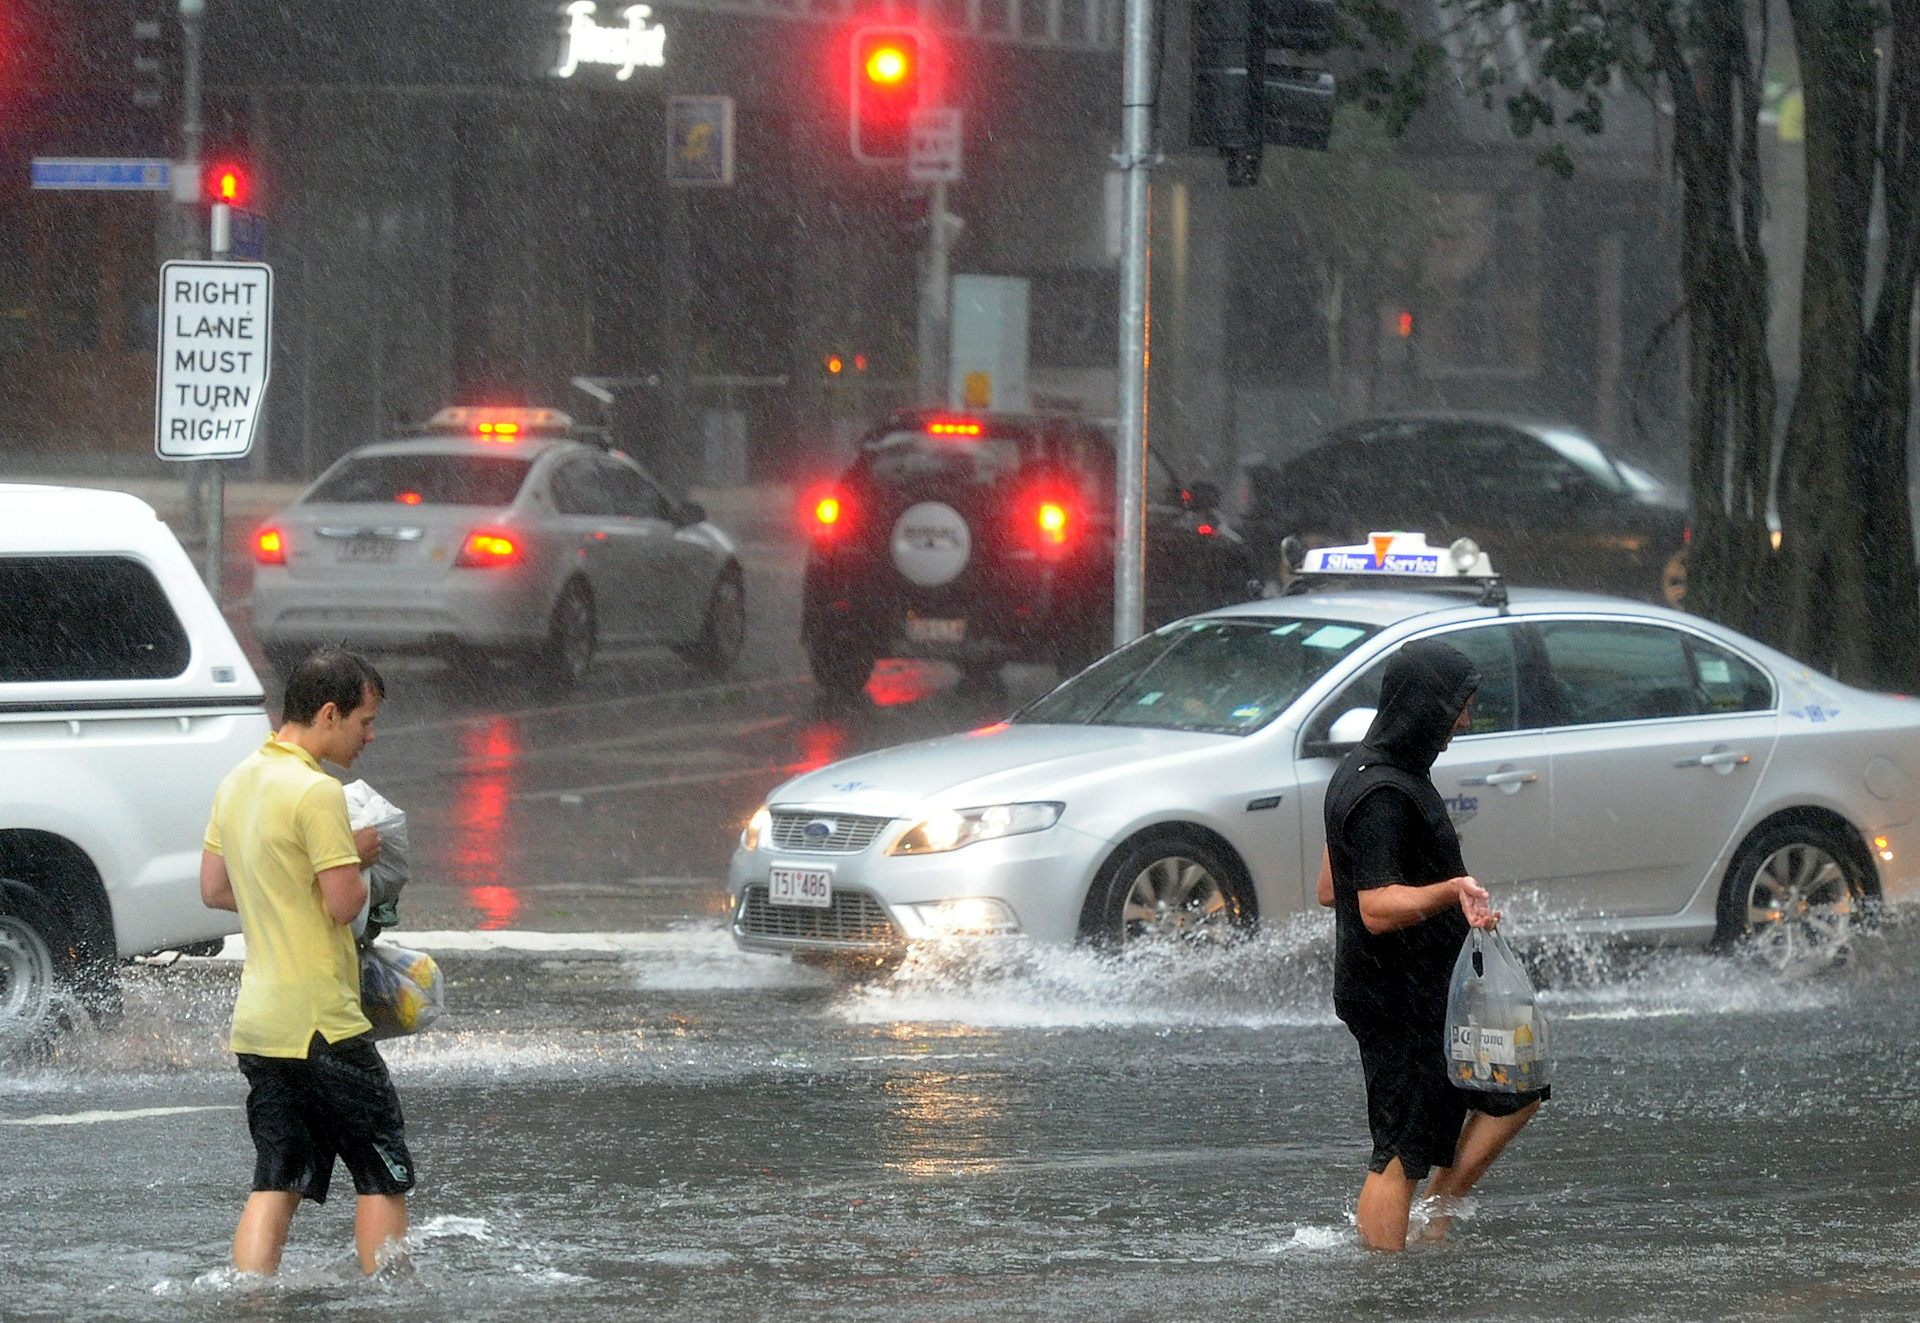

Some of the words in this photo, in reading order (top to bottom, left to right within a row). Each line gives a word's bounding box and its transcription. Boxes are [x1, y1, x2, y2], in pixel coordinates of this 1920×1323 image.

[175, 281, 257, 304] RIGHT
[176, 315, 253, 339] LANE
[175, 350, 253, 374] MUST
[175, 384, 251, 408] TURN
[170, 418, 246, 441] RIGHT
[1326, 553, 1369, 570] Silver
[1383, 554, 1437, 573] Service
[1460, 1028, 1504, 1047] Crona
